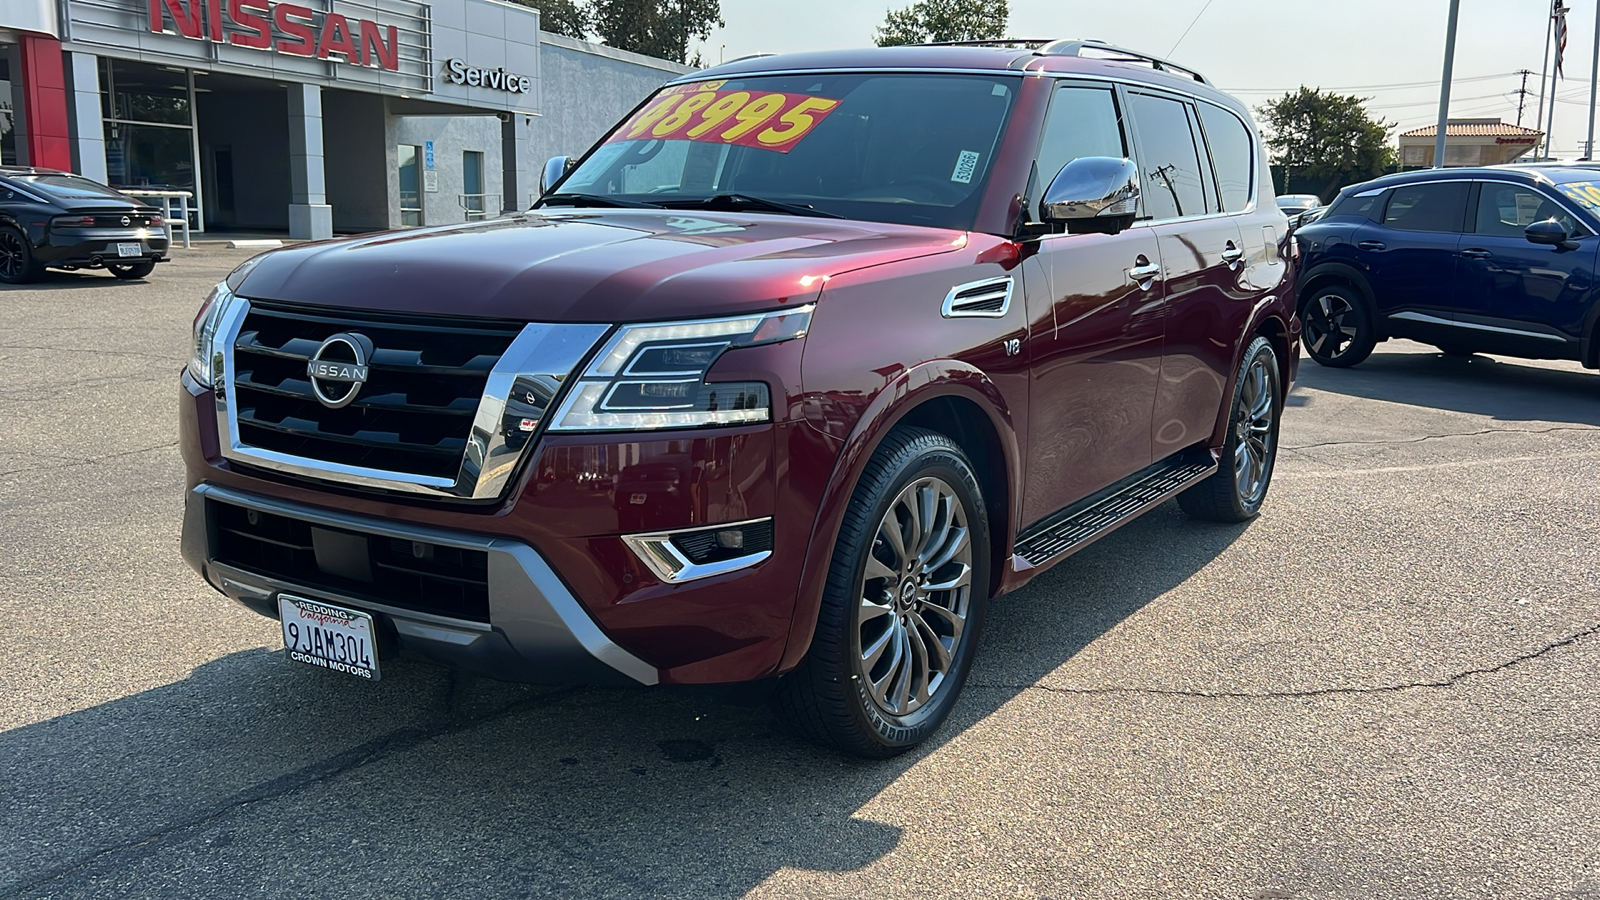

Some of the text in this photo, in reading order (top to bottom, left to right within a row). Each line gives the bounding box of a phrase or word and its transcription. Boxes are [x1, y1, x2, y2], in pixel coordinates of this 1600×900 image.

[149, 0, 399, 71] NISSAN
[448, 57, 532, 95] Service
[626, 91, 838, 147] 48995
[1494, 136, 1537, 145] Speedway
[1003, 338, 1020, 357] V8
[307, 362, 366, 380] NISSAN
[298, 601, 348, 619] REDDING
[299, 607, 357, 630] California
[288, 621, 371, 669] 9JAM304
[290, 651, 372, 679] CROWN MOTORS
